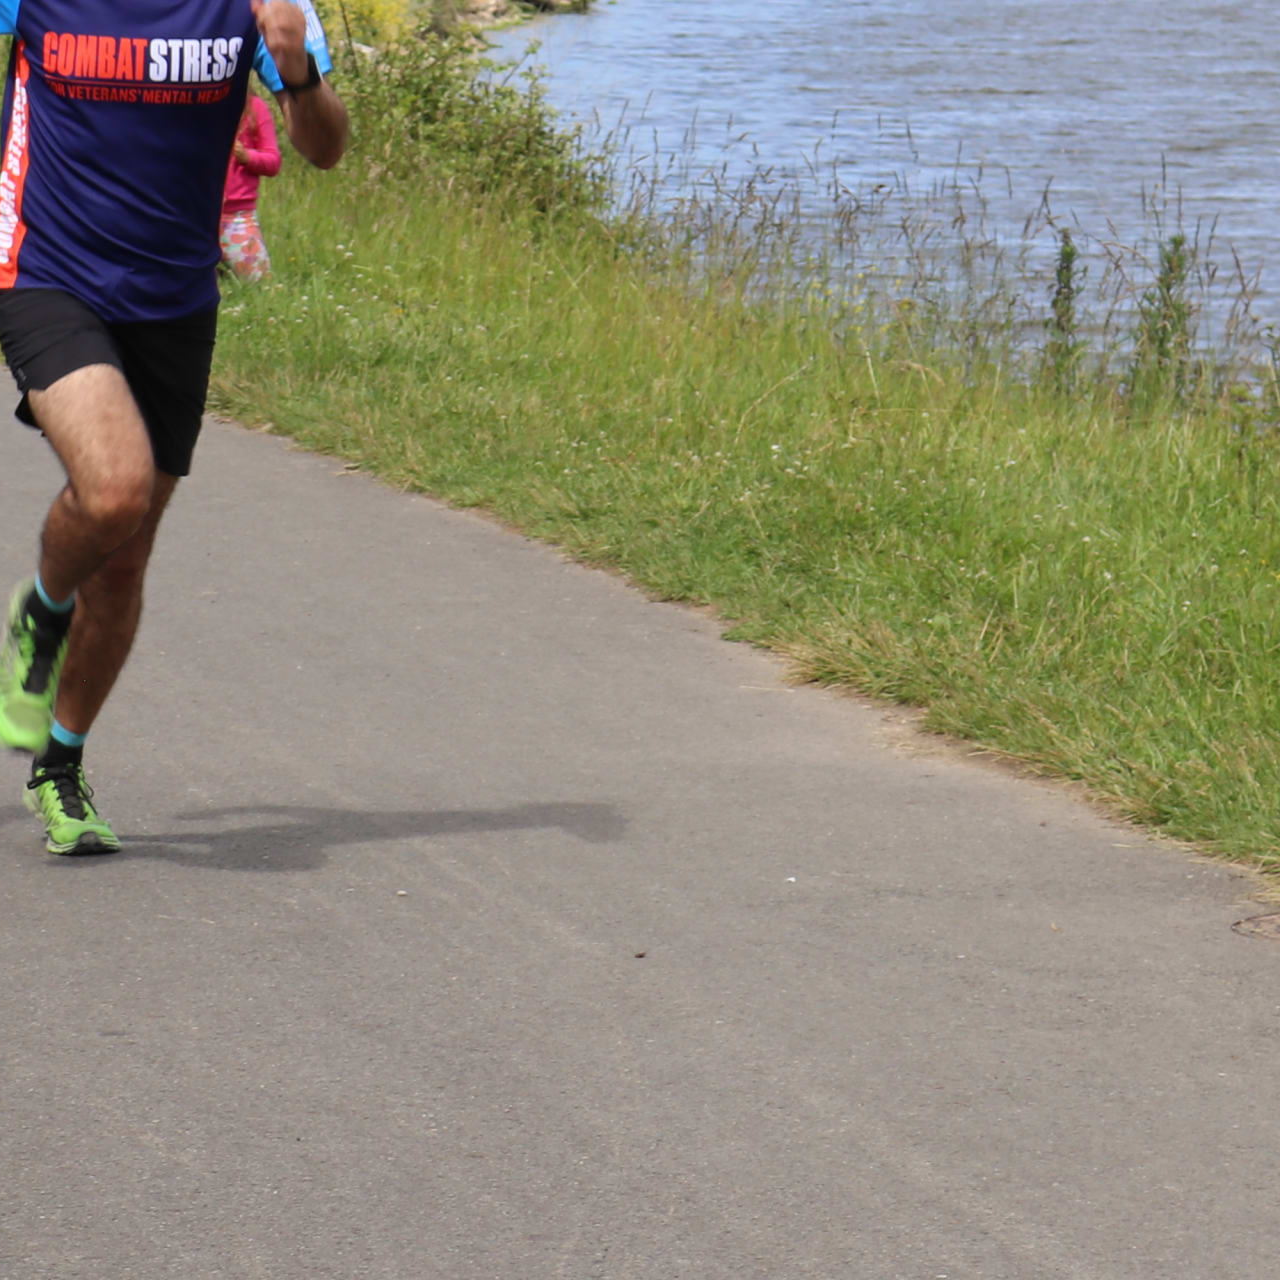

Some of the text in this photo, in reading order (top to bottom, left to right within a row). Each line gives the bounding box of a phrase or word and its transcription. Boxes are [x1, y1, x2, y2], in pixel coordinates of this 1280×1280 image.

[42, 31, 243, 82] COMBAT STRESS
[142, 89, 194, 104] MENTAL
